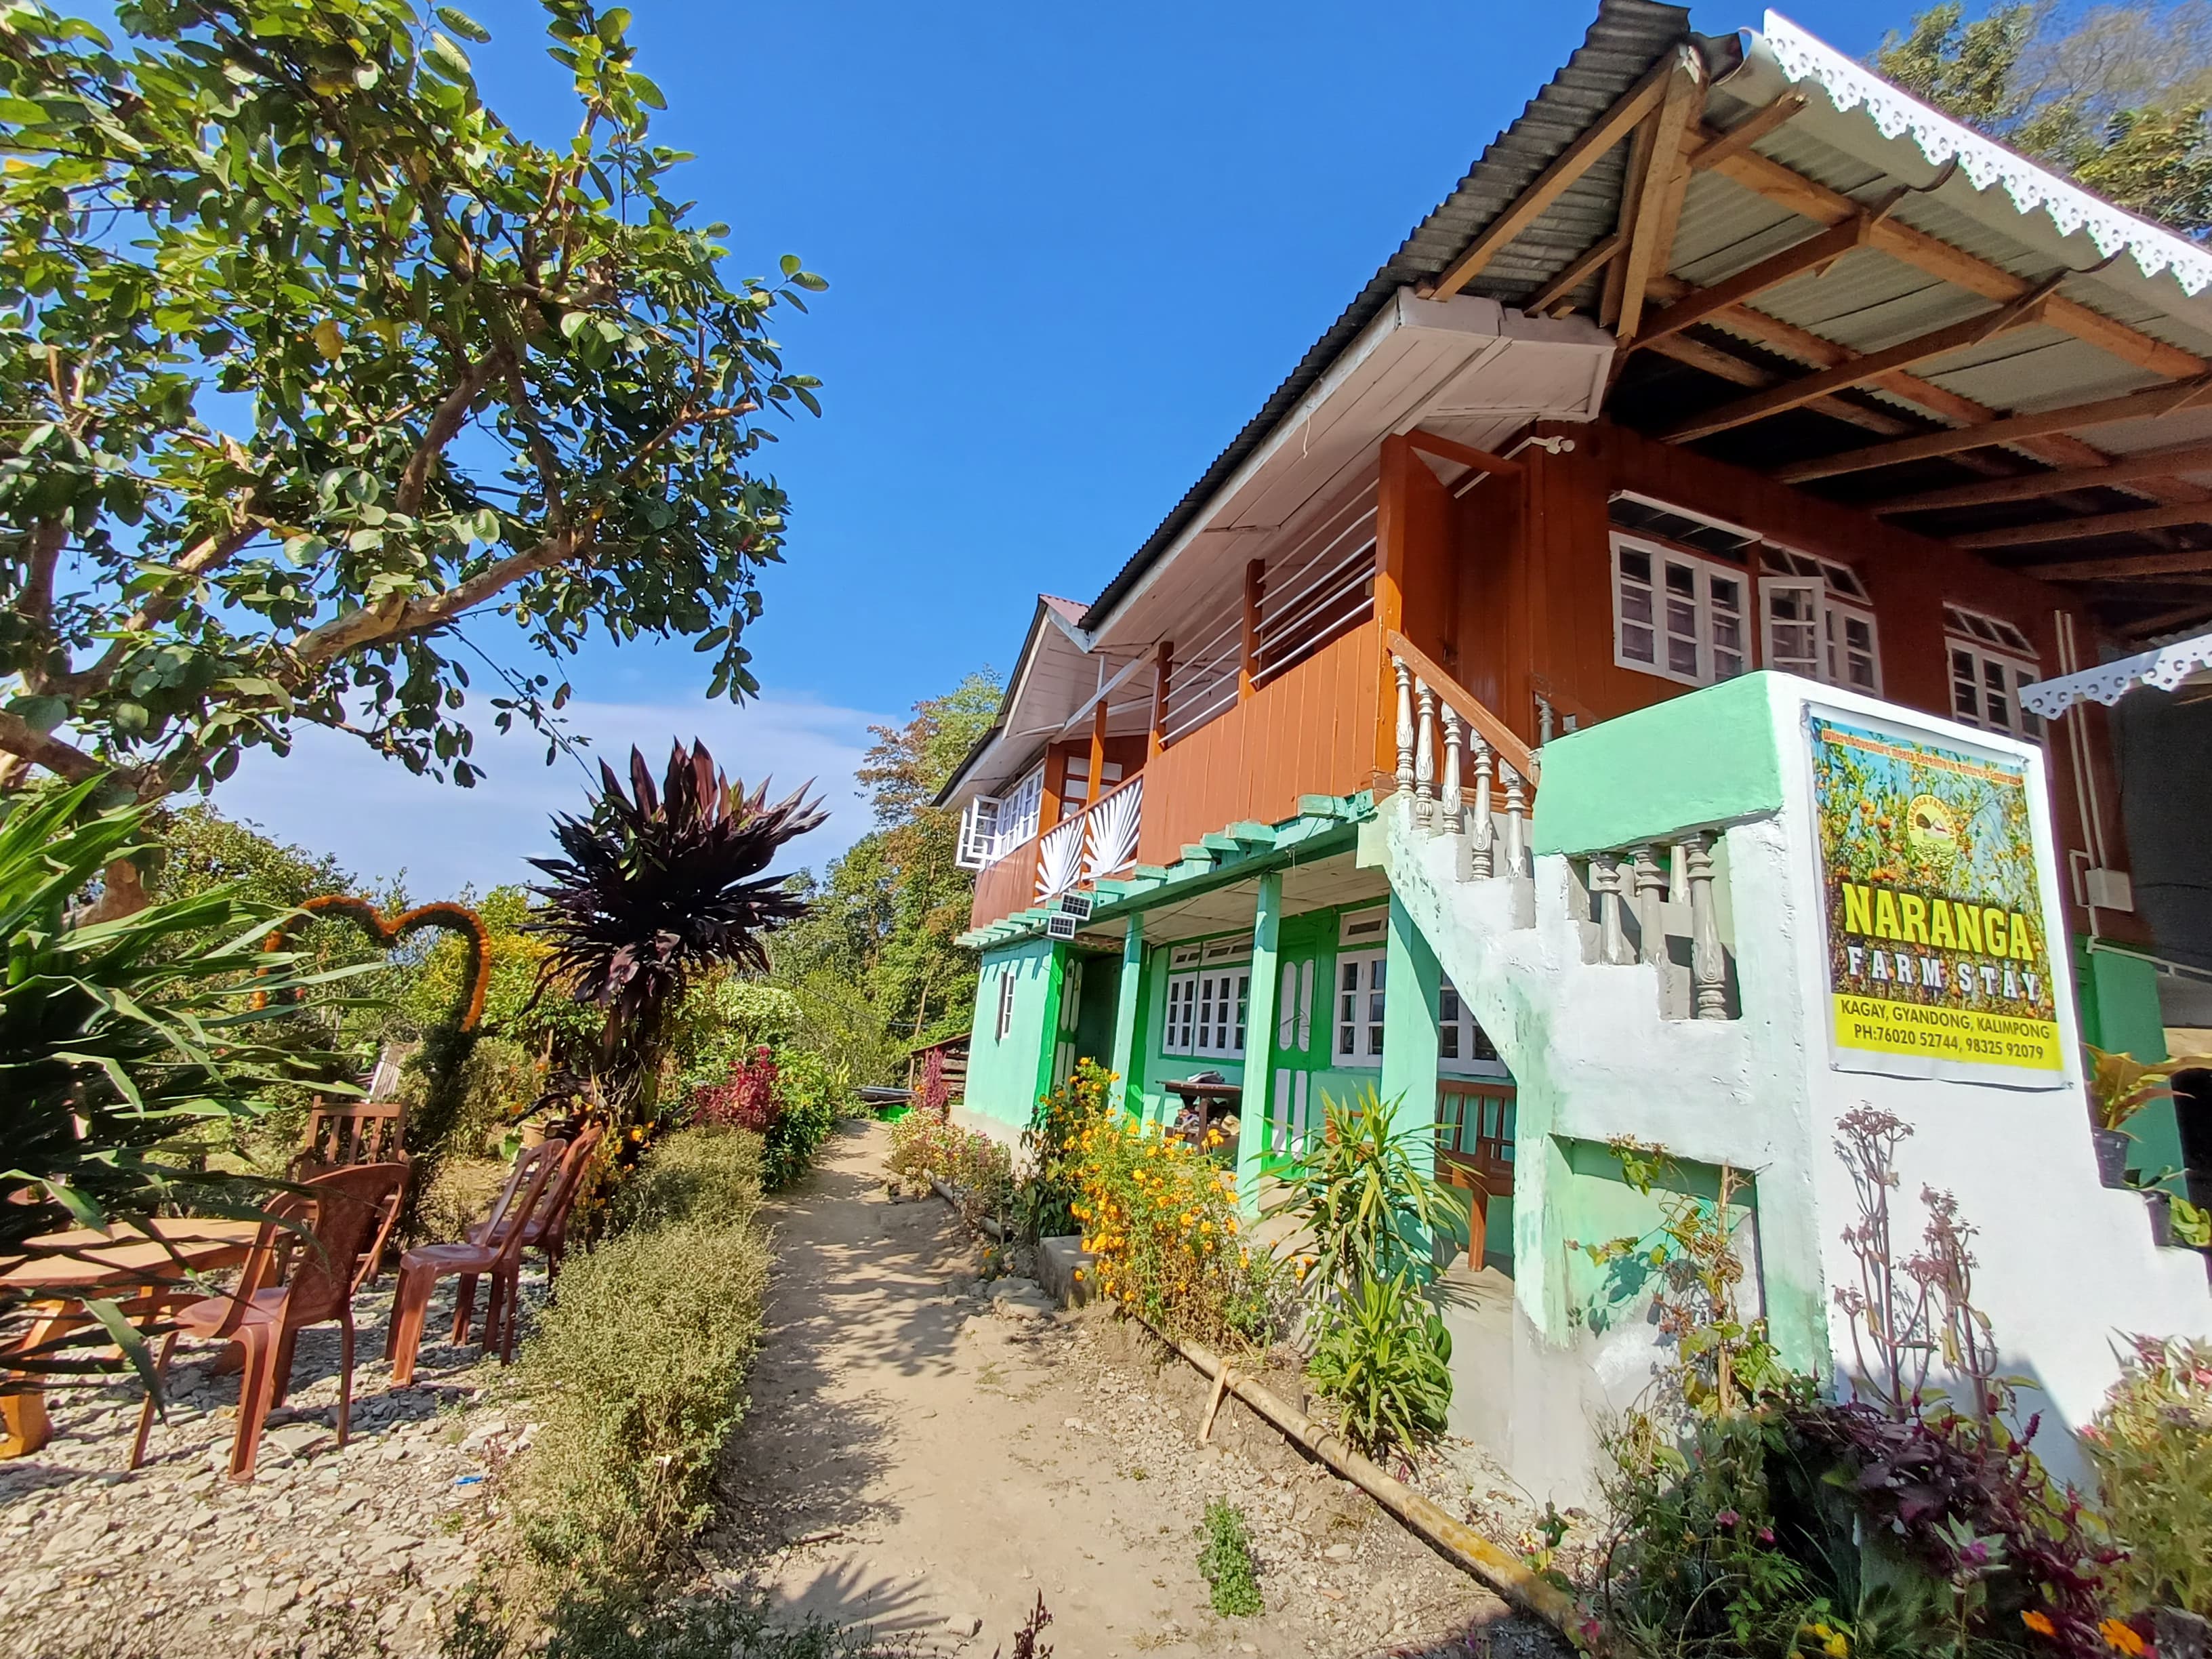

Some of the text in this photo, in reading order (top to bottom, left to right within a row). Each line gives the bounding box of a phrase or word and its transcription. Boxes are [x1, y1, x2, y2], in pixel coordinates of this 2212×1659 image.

[1842, 882, 2034, 961] NARANGA
[1847, 945, 2037, 1001] FARM STAY
[1841, 999, 2050, 1040] KAGAY, GYANDONG, KALIMPONG
[1854, 1023, 2044, 1060] PH:76020 52744, 98325 92079
